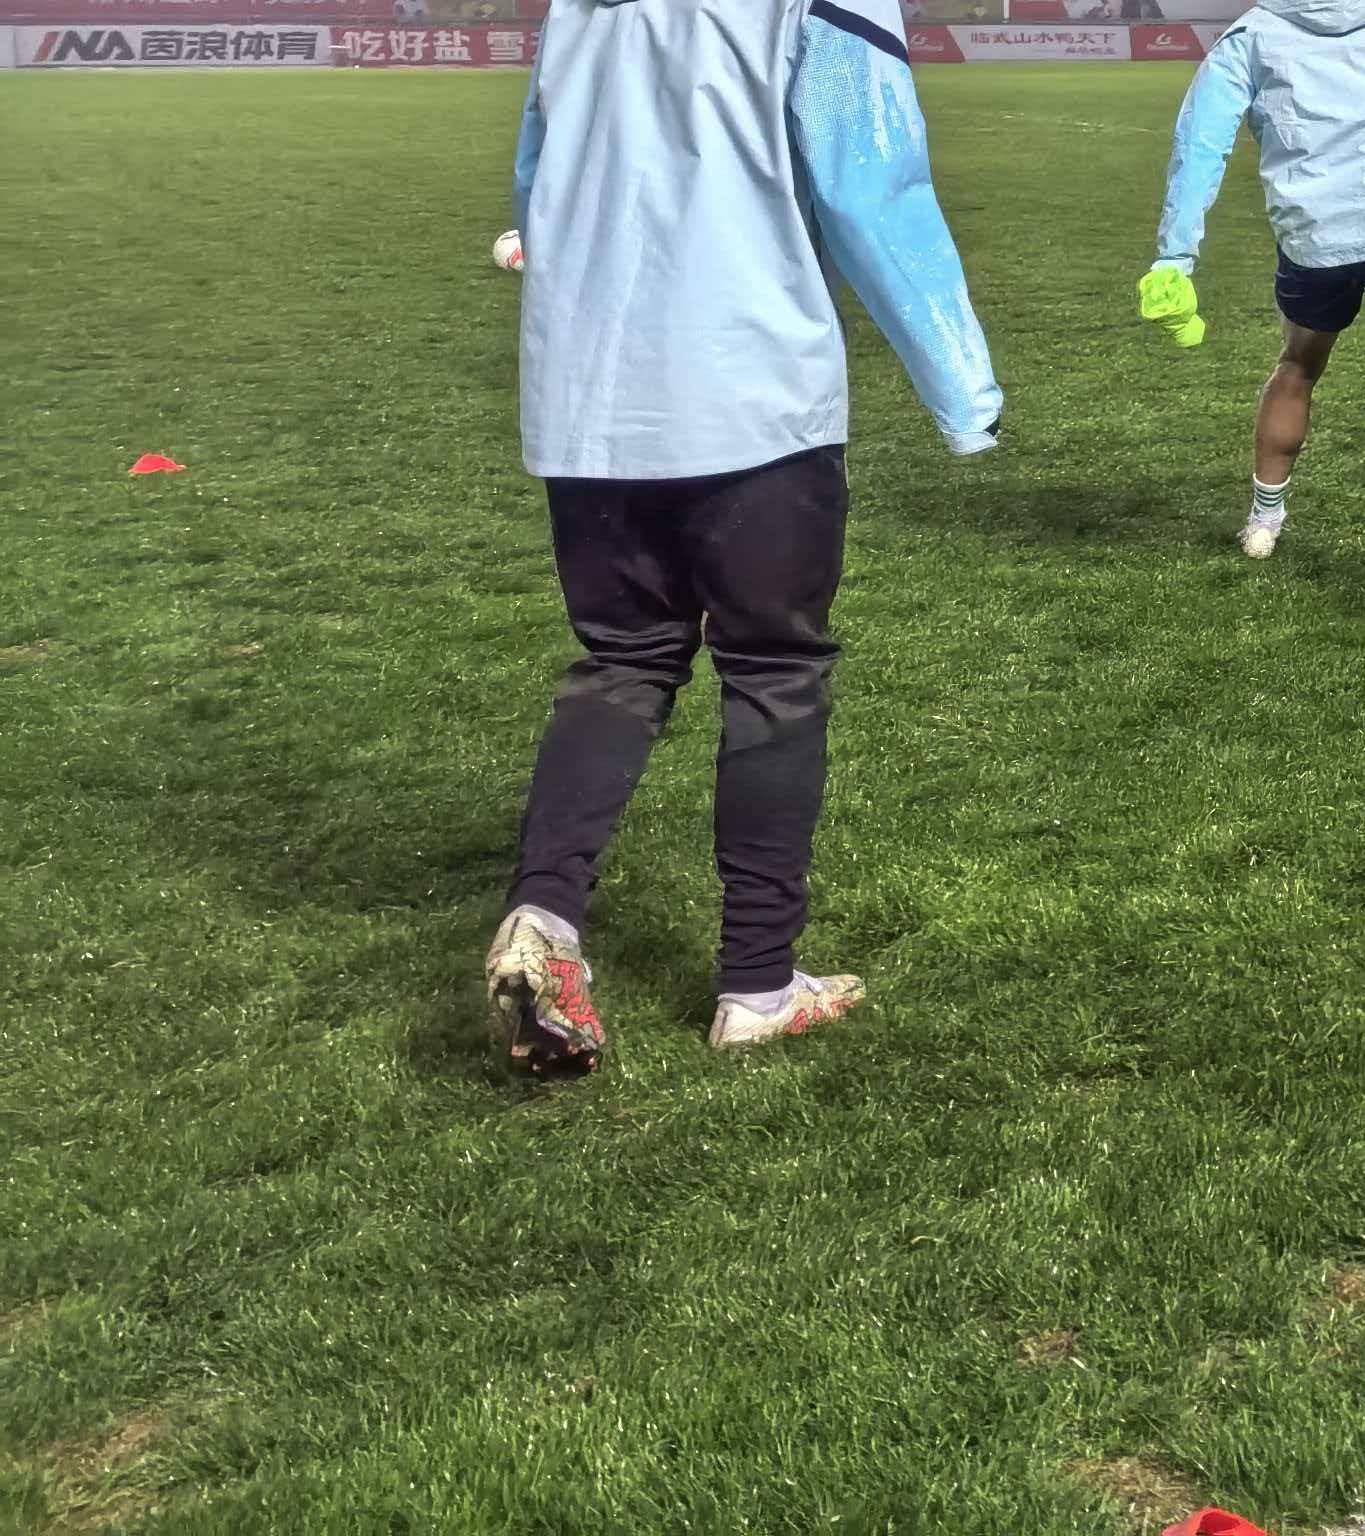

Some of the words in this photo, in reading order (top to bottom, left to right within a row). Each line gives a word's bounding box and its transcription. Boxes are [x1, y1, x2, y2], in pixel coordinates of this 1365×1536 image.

[140, 29, 318, 62] 茵浪体育
[343, 29, 472, 62] 吃好盐
